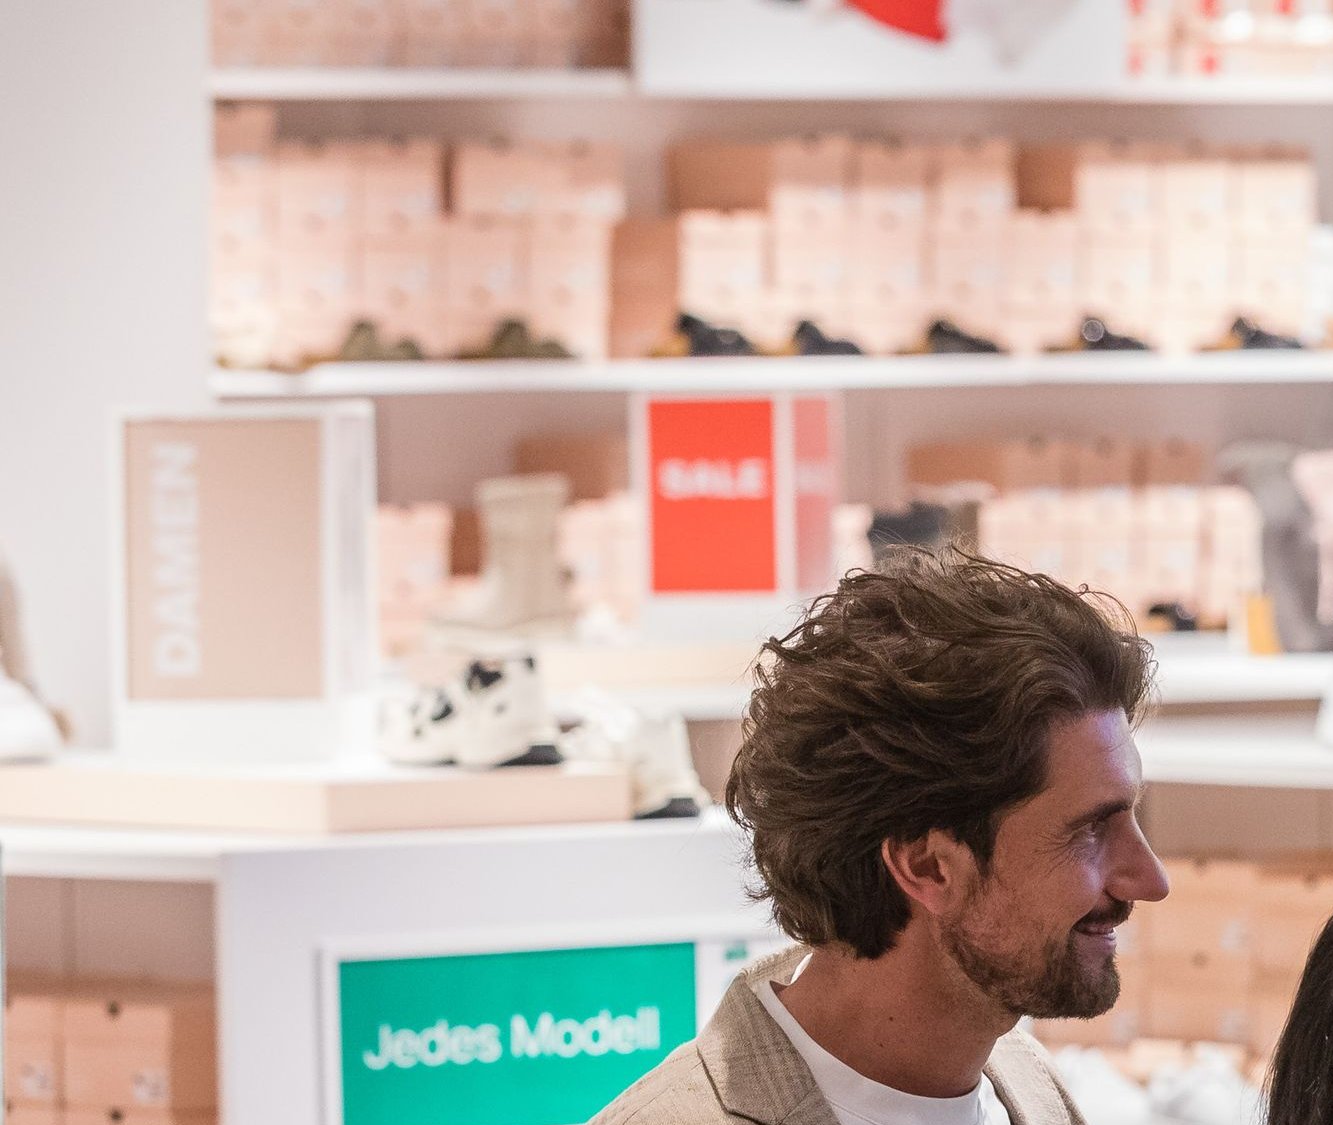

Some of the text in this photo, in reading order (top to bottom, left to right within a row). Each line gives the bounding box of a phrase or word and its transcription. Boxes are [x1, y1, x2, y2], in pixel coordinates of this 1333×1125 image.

[659, 458, 767, 499] SALE
[151, 442, 201, 677] DAMEN
[363, 1006, 661, 1070] Jedes Modell
